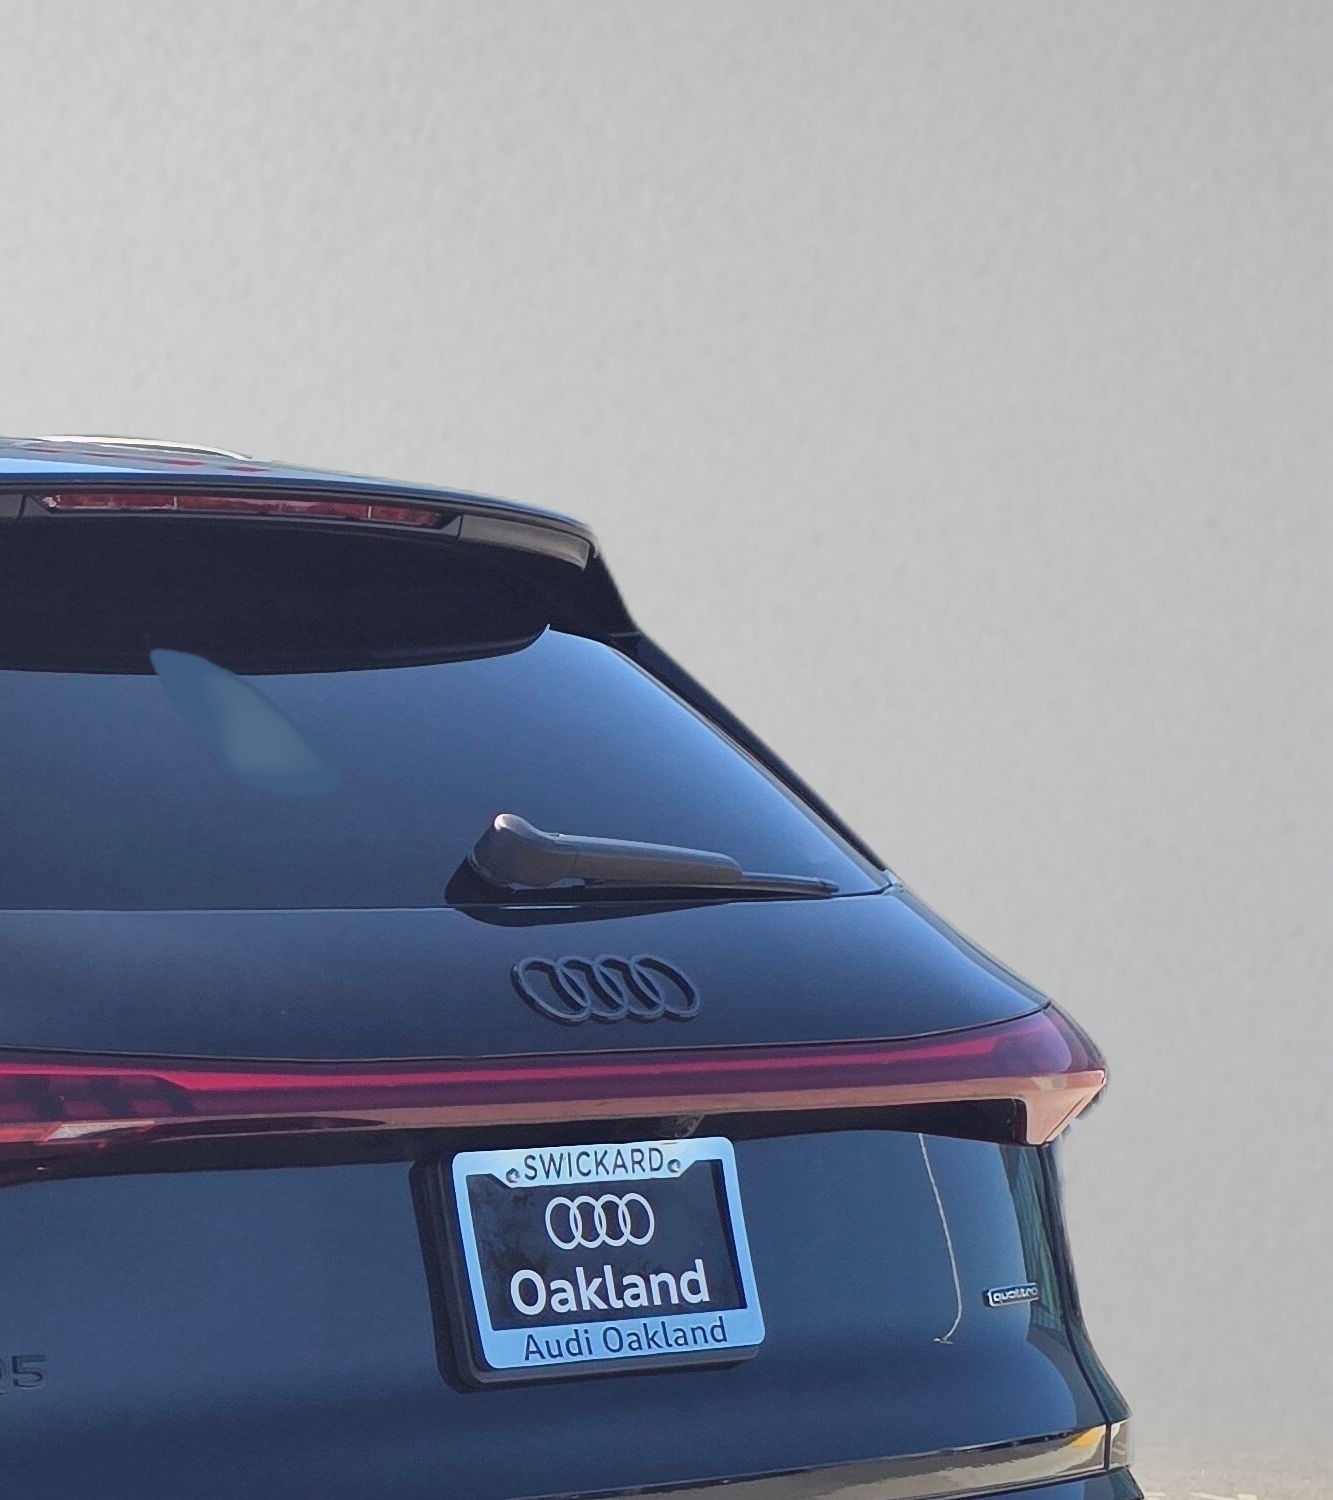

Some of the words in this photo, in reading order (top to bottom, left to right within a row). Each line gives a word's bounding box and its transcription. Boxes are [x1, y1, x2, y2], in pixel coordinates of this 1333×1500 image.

[523, 1147, 664, 1181] SWICKARD
[510, 1258, 711, 1316] Oakland
[524, 1328, 591, 1361] Audi
[602, 1316, 728, 1353] Oakland
